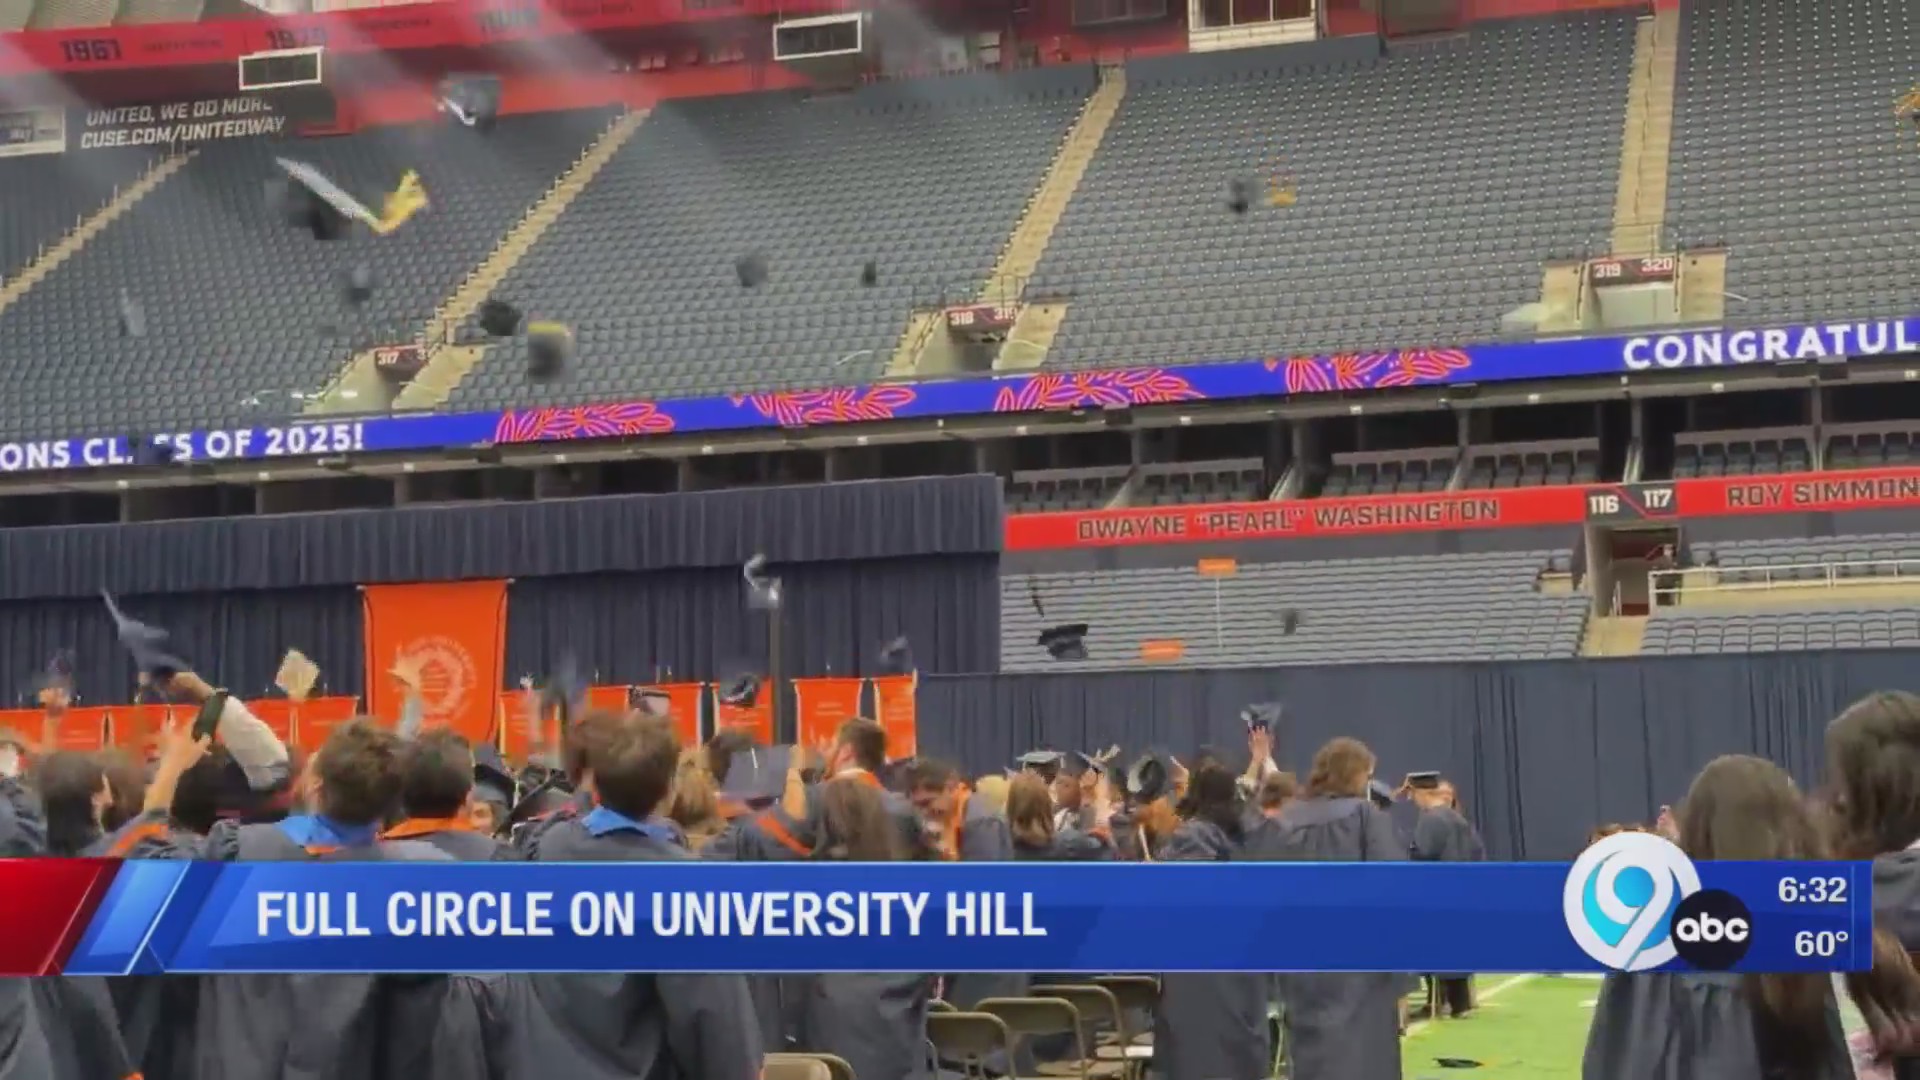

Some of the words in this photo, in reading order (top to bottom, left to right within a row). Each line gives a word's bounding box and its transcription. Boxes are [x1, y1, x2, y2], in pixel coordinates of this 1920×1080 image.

[160, 102, 188, 120] WE
[193, 100, 218, 117] DO
[1594, 263, 1621, 278] 319
[1641, 257, 1673, 273] 320
[1623, 320, 1916, 369] CONGRATUL
[377, 351, 399, 366] 317
[0, 440, 71, 471] ONS
[83, 432, 193, 466] CLS
[205, 429, 252, 459] OF
[264, 423, 364, 454] 2025!
[1642, 489, 1673, 508] 117
[1727, 484, 1784, 508] ROY
[1794, 477, 1920, 504] SIMMON
[1590, 495, 1619, 514] 116
[1078, 515, 1186, 541] DWAYNE
[1195, 509, 1305, 533] "PEARL"
[1314, 499, 1500, 527] WASHINGTON
